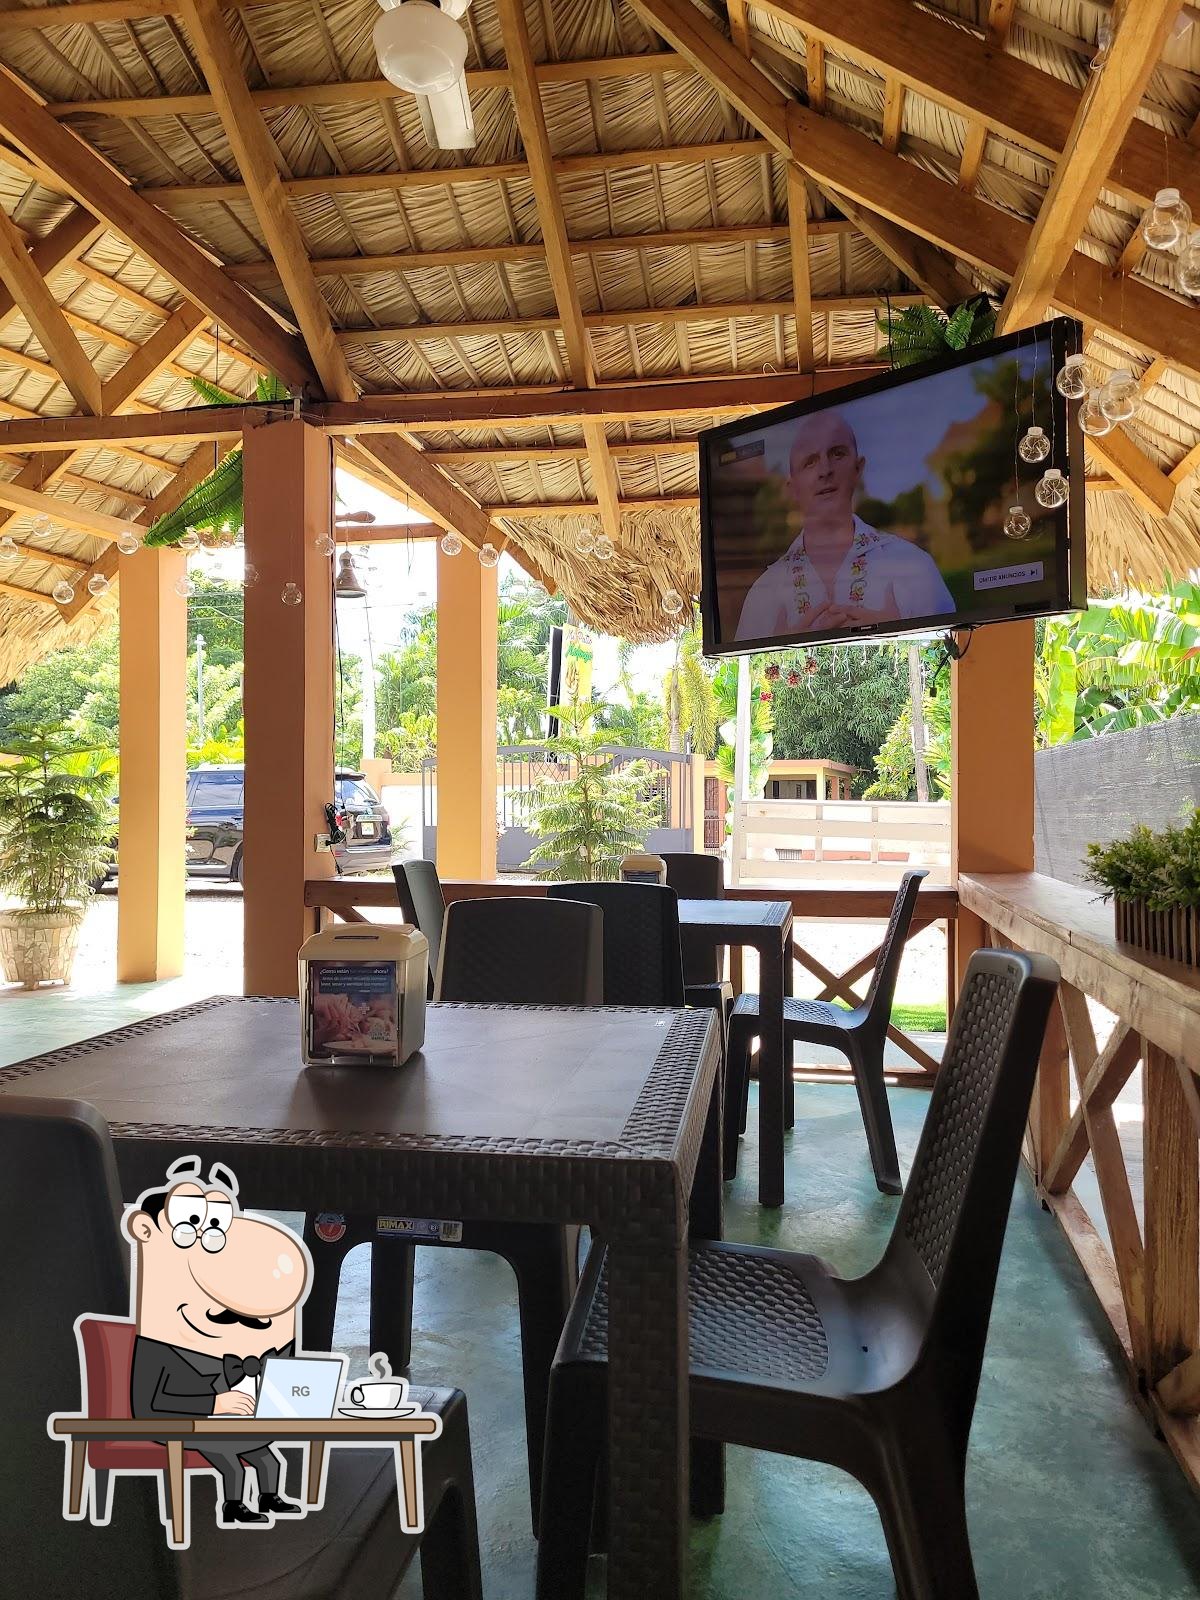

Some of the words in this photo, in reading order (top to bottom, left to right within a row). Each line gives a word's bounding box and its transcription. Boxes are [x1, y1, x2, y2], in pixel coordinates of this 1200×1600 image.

[979, 575, 997, 583] OMITIR
[998, 571, 1026, 580] ANUNCIOS
[378, 1219, 414, 1231] RIMAX
